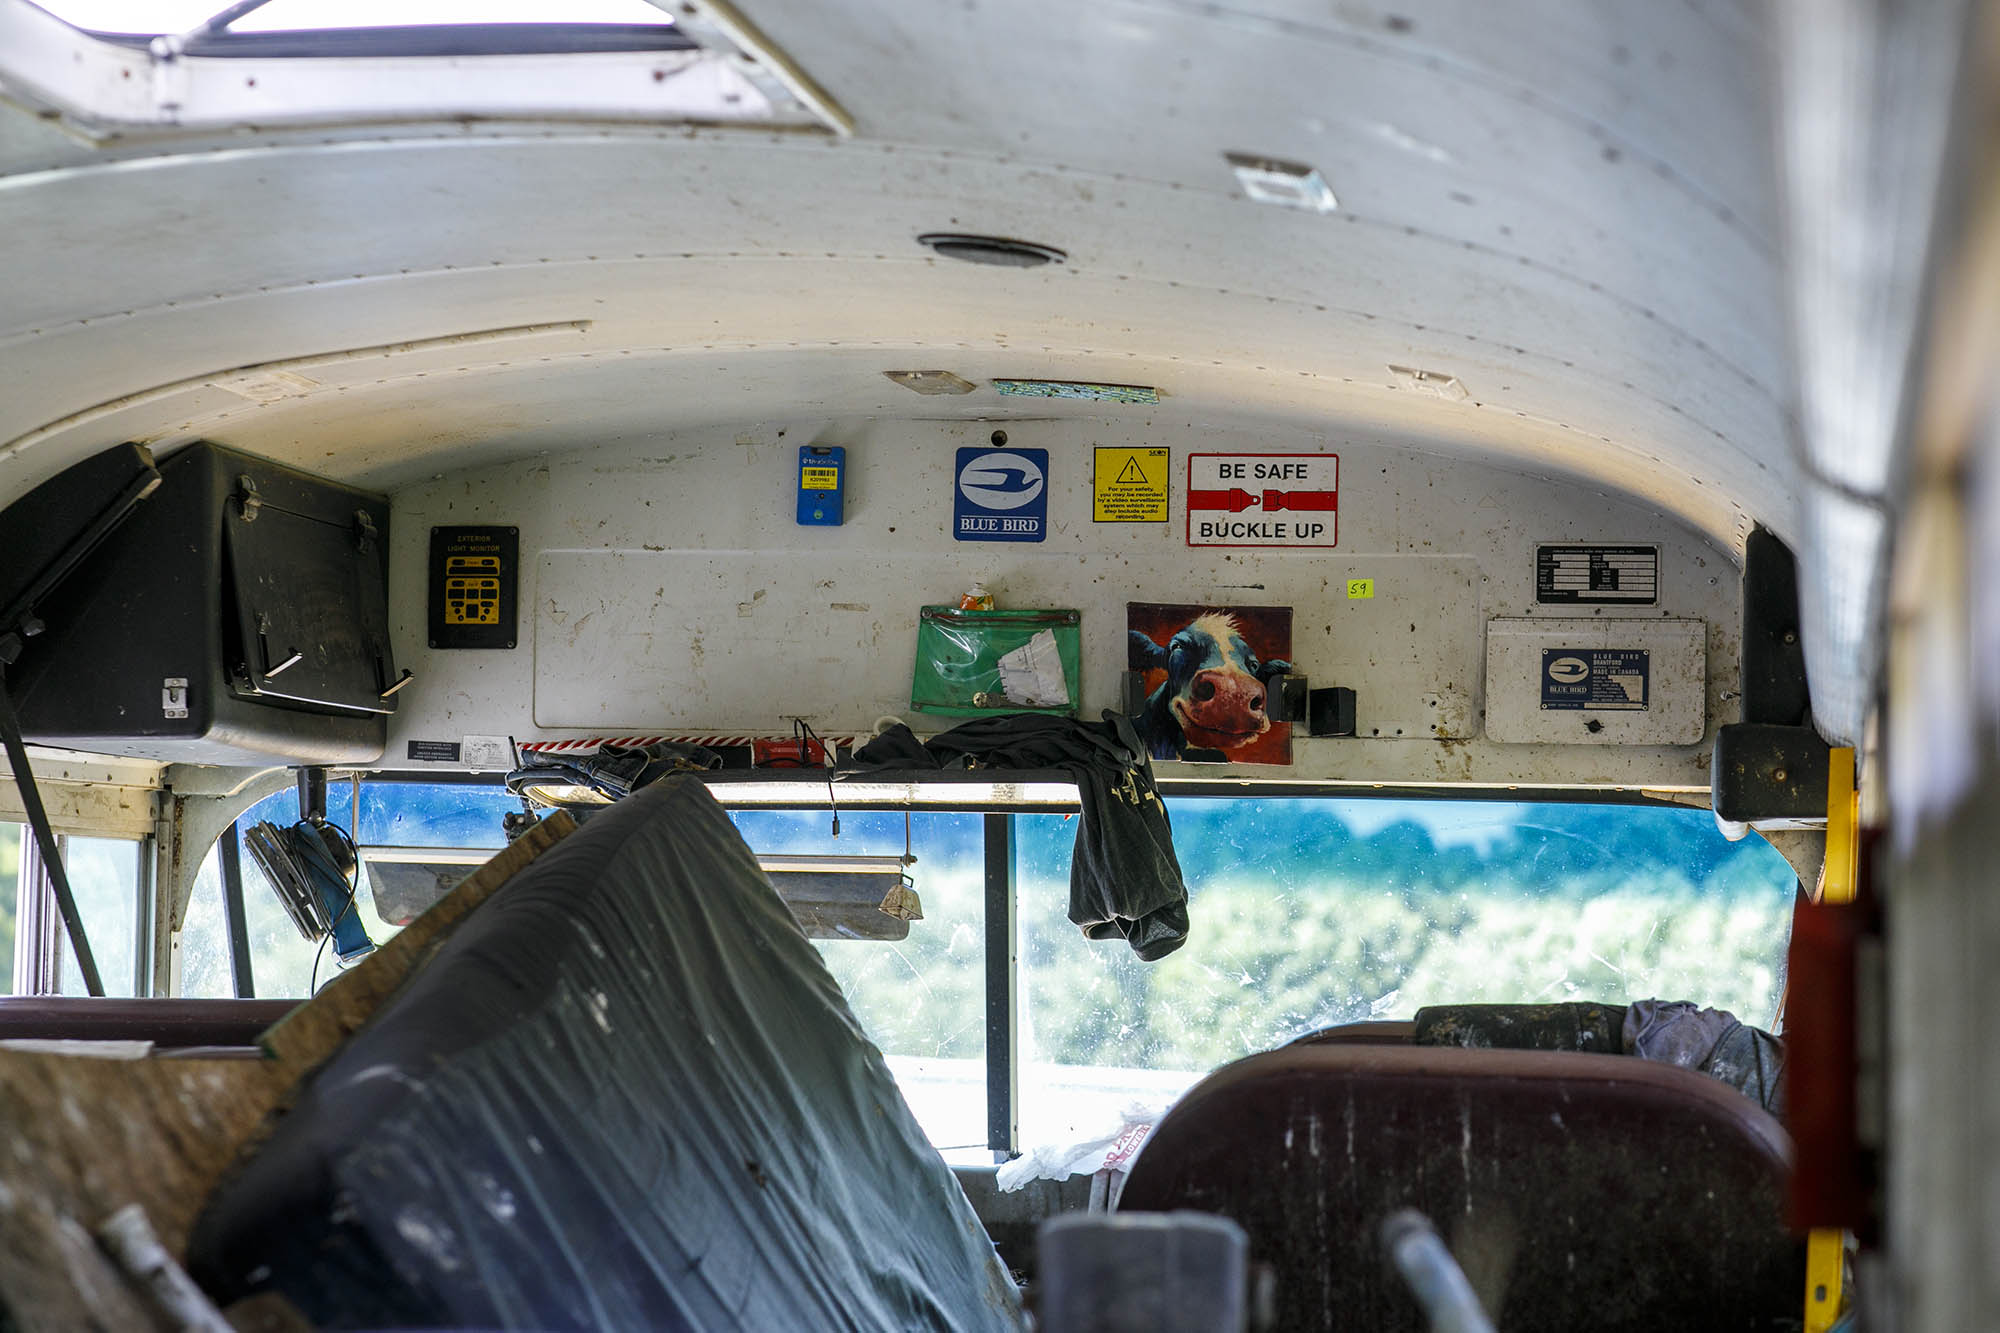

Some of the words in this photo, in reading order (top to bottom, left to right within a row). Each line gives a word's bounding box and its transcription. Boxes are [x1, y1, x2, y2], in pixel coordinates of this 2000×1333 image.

[1219, 463, 1246, 479] BE
[1254, 463, 1308, 479] SAFE
[960, 518, 998, 531] BLUE
[1002, 519, 1039, 532] BIRD
[1200, 522, 1287, 538] BUCKLE
[1295, 523, 1324, 538] UP
[1350, 582, 1366, 595] 59
